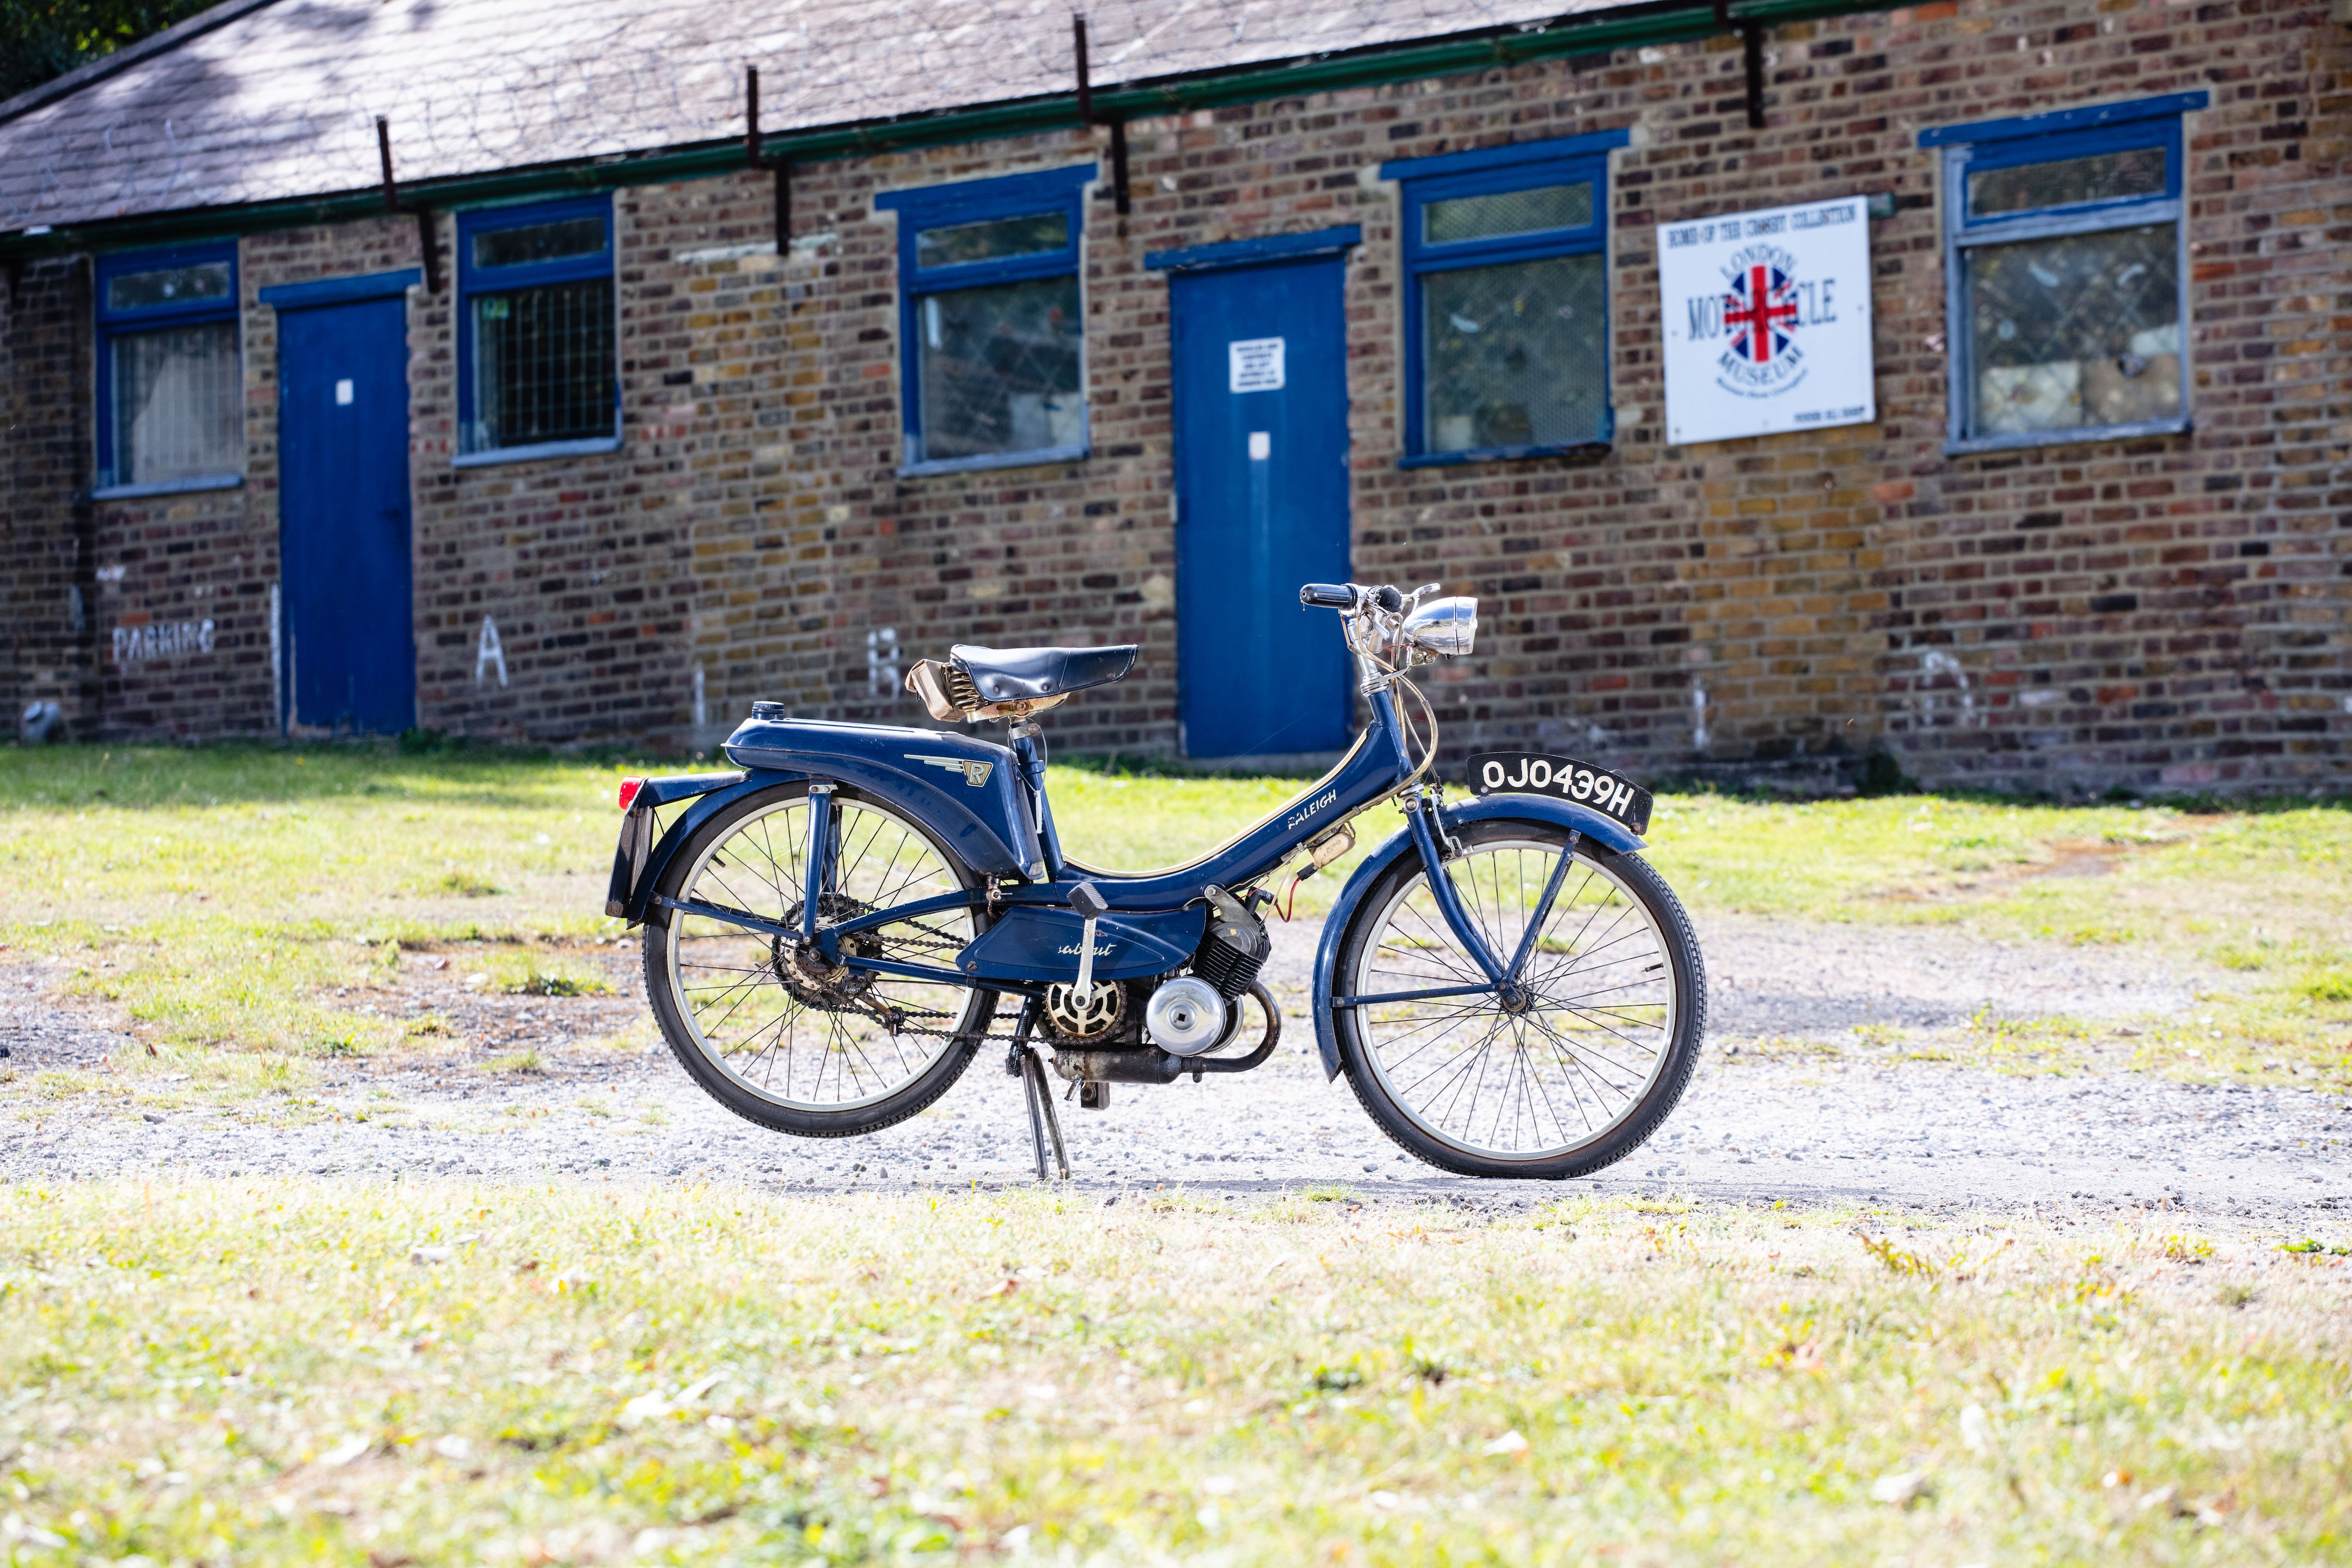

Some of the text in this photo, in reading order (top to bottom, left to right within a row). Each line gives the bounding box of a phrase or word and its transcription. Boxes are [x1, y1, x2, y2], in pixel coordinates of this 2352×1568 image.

[1720, 244, 1798, 280] LONDON
[1717, 346, 1804, 386] MUSEUM
[113, 619, 215, 664] PARKING
[475, 614, 508, 689] A
[970, 764, 983, 783] R
[1288, 789, 1337, 830] RALEIGH
